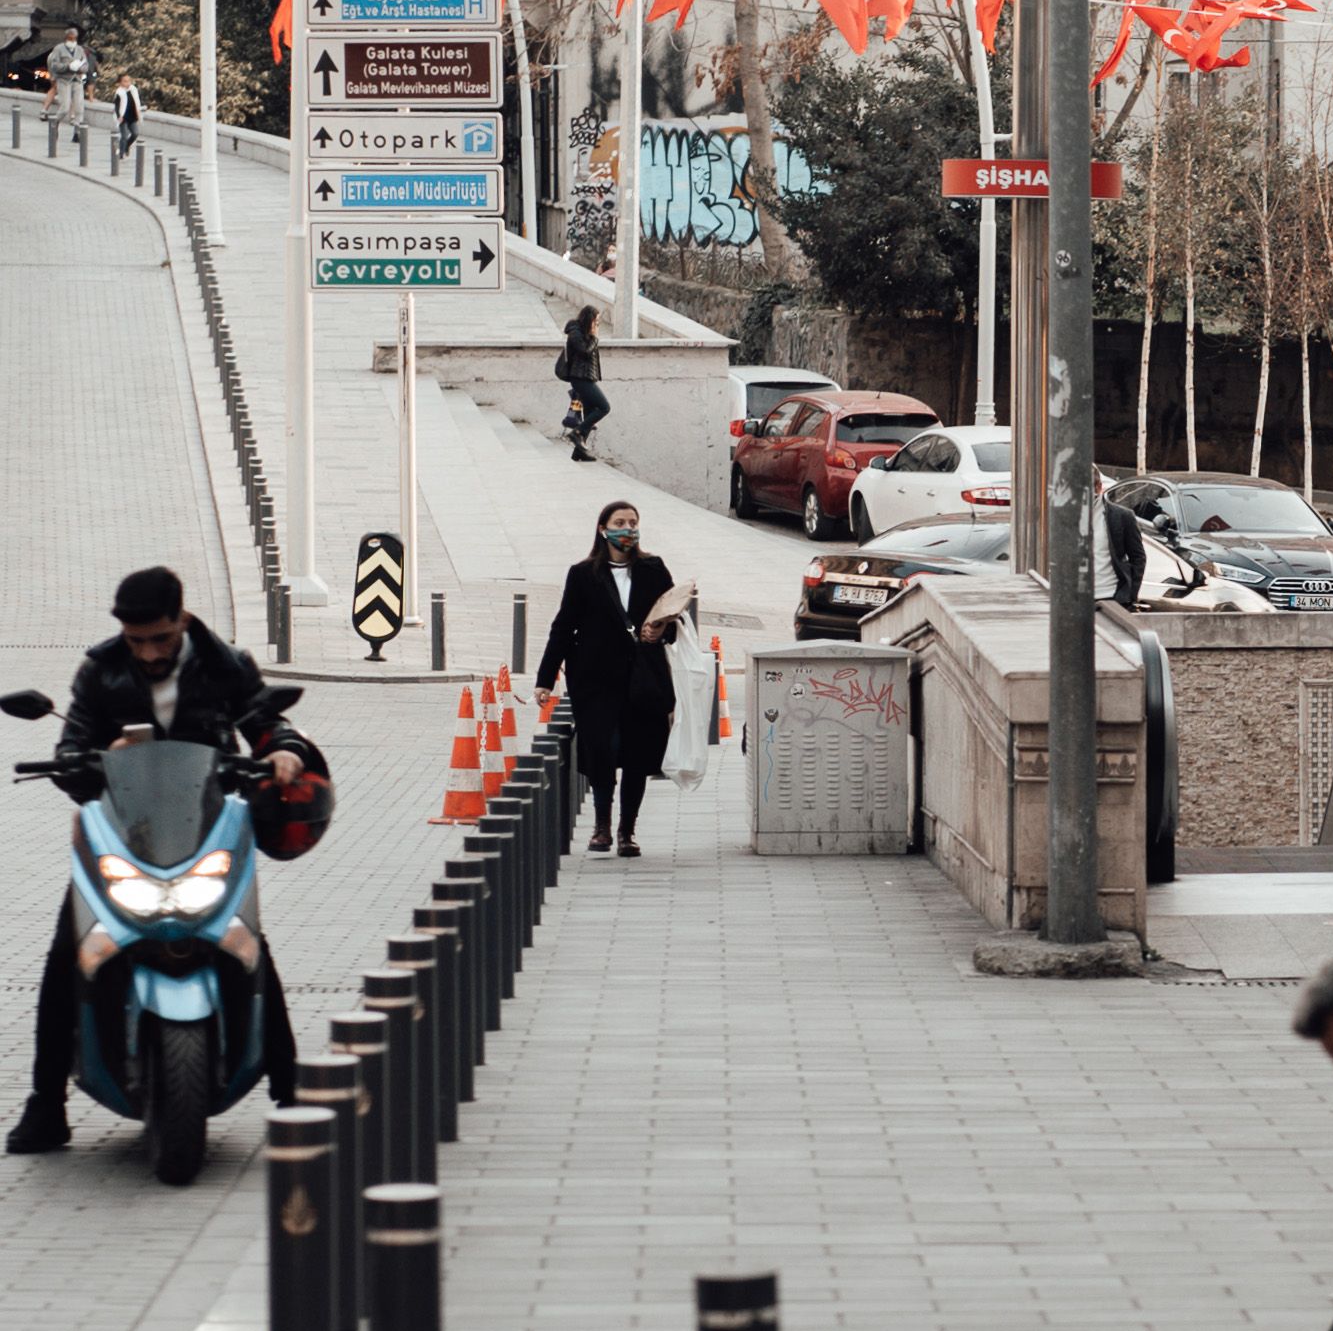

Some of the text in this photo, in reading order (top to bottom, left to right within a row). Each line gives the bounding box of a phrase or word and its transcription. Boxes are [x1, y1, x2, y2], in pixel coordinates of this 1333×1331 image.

[342, 4, 363, 19] Eğt.
[366, 7, 378, 16] ve
[408, 4, 464, 16] Hastanesi
[366, 46, 468, 60] Galata Kulesi
[363, 62, 472, 78] (Galata Tower)
[346, 81, 490, 95] Galata Mevlevihanesi Müzesi
[339, 129, 457, 154] Otopark
[975, 165, 1050, 189] ŞİŞHA
[342, 176, 487, 205] İETT Genel Müdürlüğü
[320, 230, 461, 256] Kasımpaşa
[318, 259, 459, 284] Çevreyolu
[1297, 597, 1306, 607] 34
[1310, 597, 1331, 607] MON
